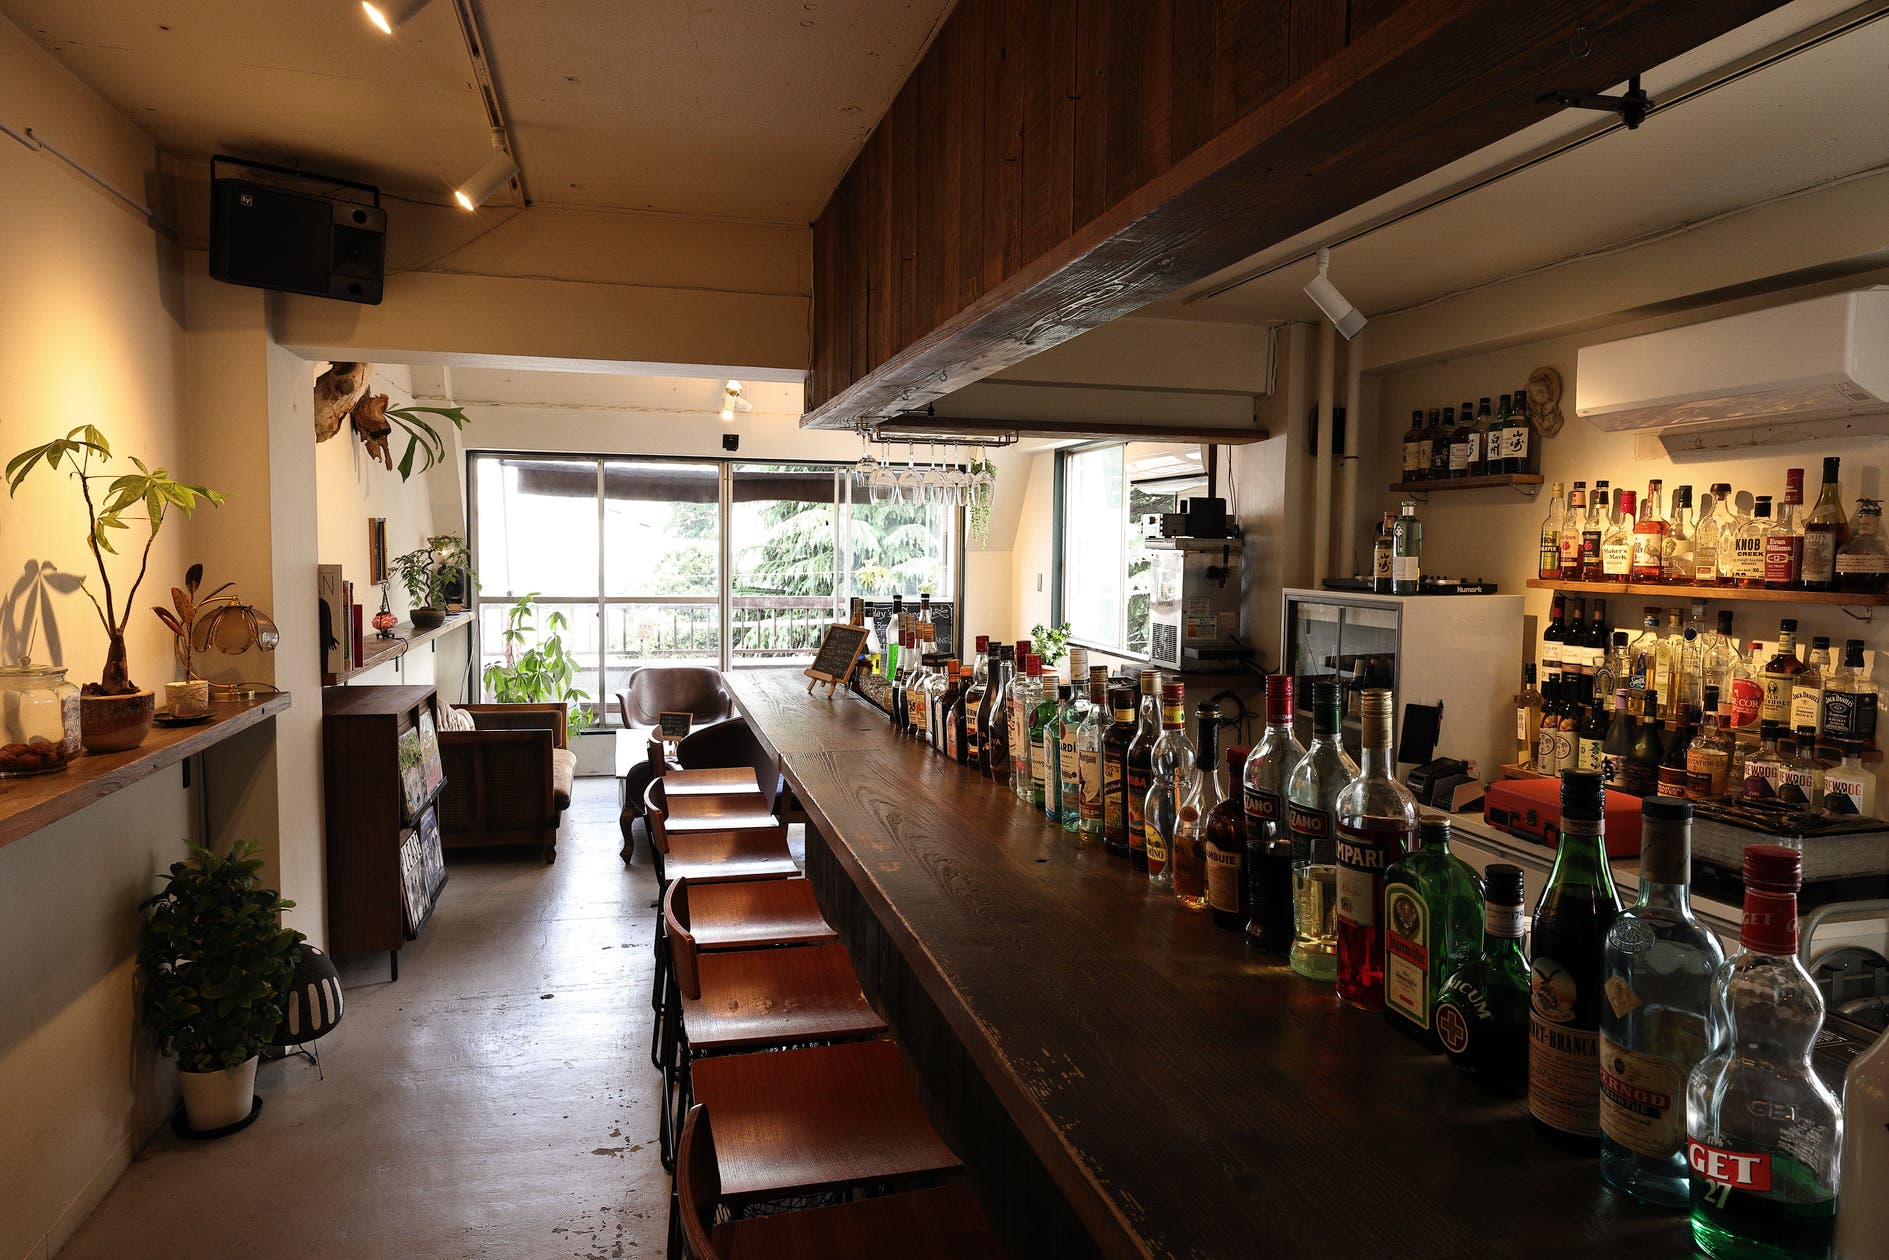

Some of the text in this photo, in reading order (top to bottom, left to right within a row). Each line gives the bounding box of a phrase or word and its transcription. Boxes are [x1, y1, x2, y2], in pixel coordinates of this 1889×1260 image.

[1735, 538, 1760, 551] KNOB
[1456, 585, 1483, 593] Numark
[1244, 794, 1274, 814] ZANO
[1289, 811, 1322, 831] ZANO
[1689, 1143, 1761, 1185] GET
[1703, 1178, 1733, 1209] 27
